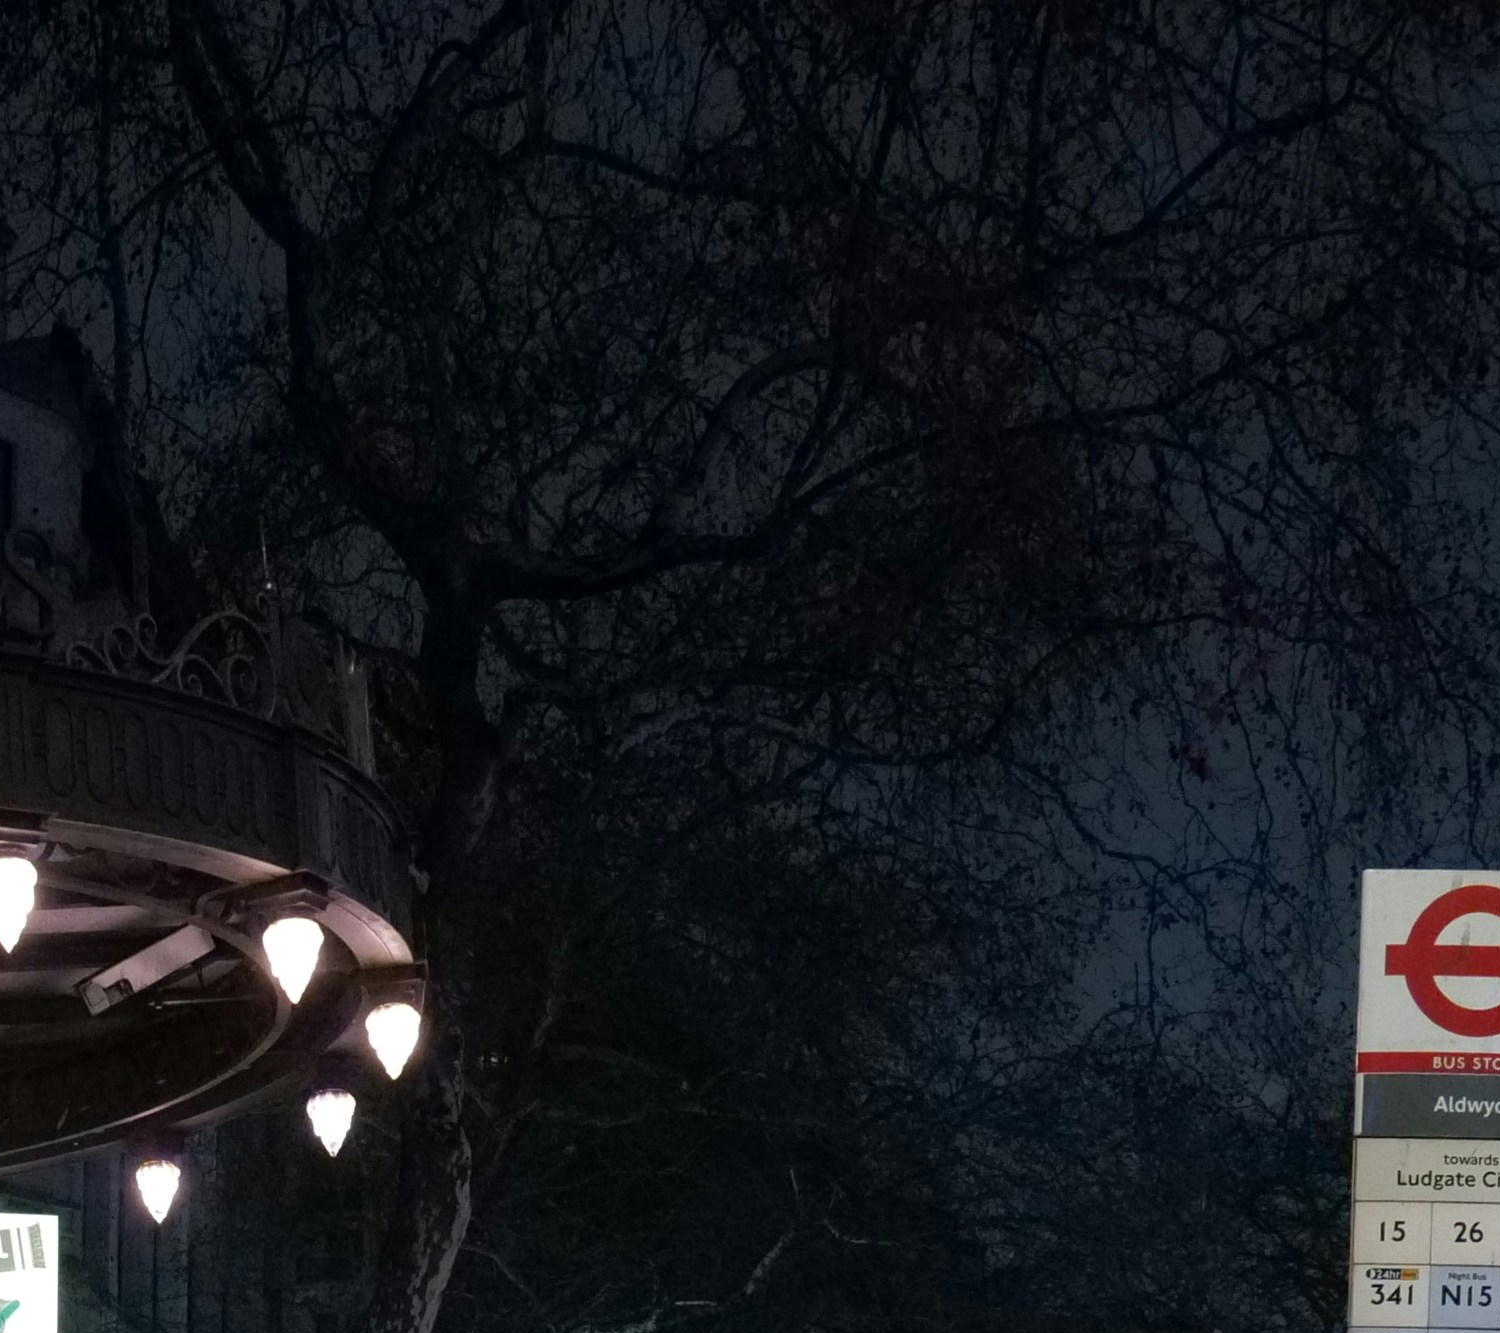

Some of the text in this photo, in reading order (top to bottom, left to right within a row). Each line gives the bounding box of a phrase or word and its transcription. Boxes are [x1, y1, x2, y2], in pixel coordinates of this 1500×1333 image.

[1432, 1056, 1466, 1070] BUS
[1443, 1154, 1499, 1166] towards
[1397, 1170, 1476, 1190] Ludgate
[1379, 1220, 1406, 1242] 15
[1453, 1221, 1484, 1243] 26
[1370, 1284, 1414, 1305] 341
[1441, 1285, 1493, 1307] N15
